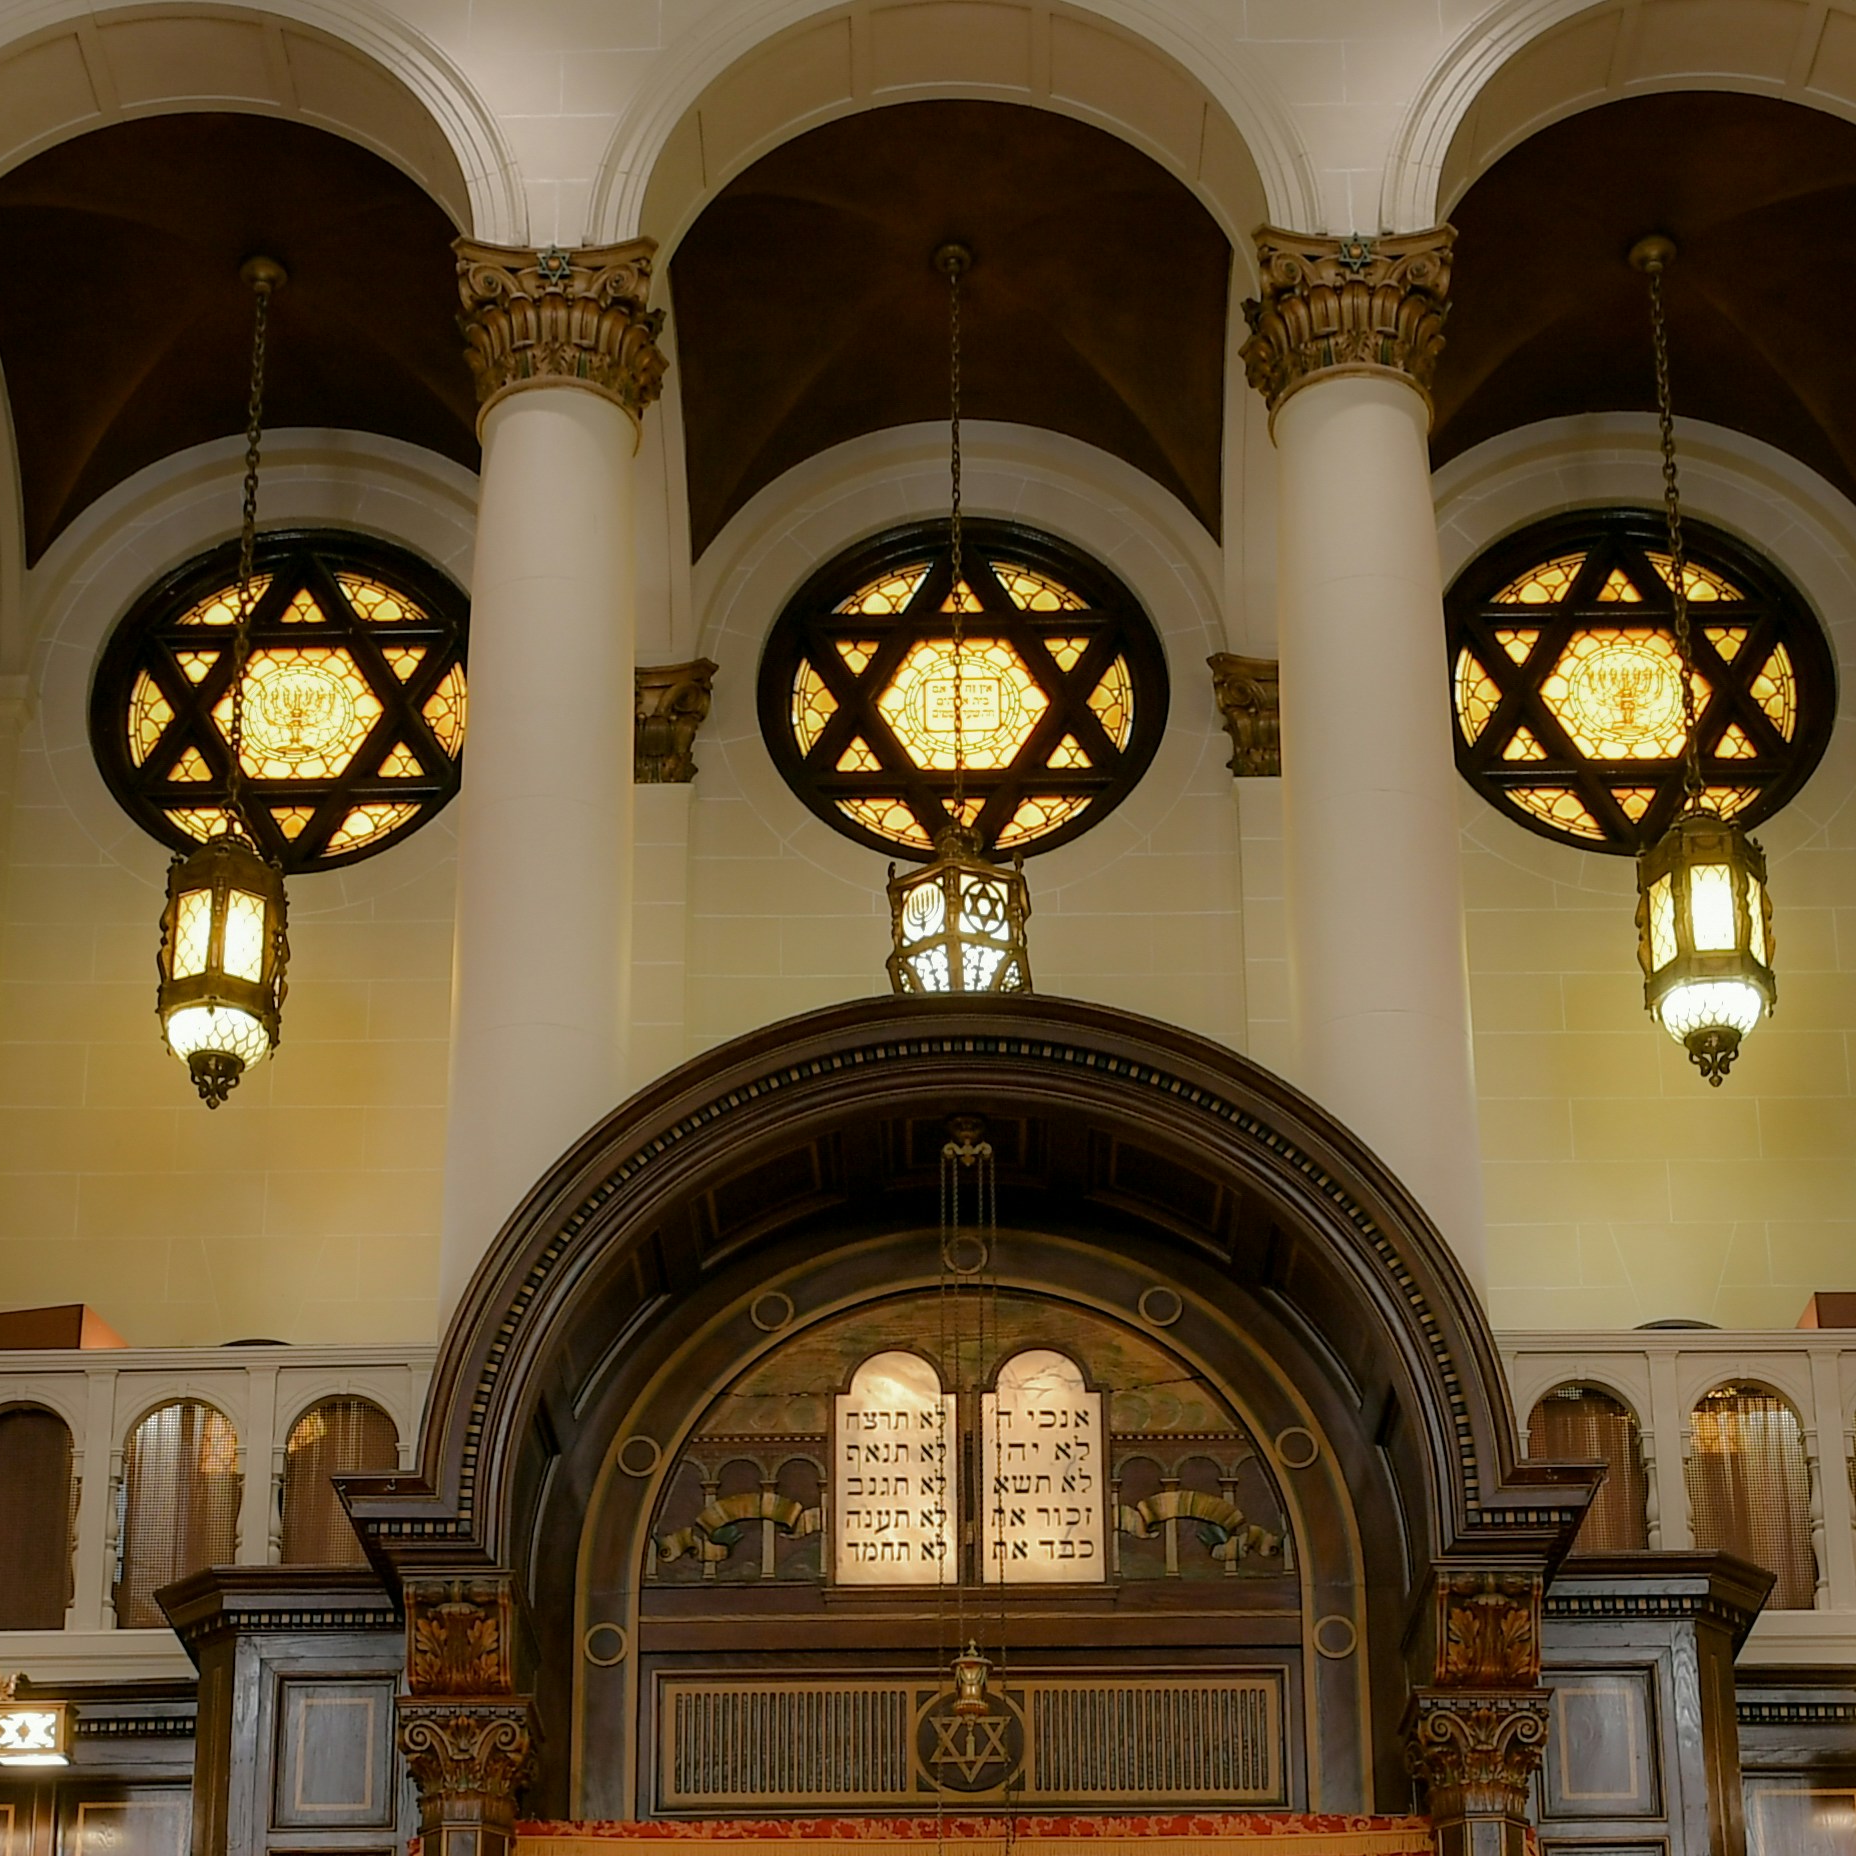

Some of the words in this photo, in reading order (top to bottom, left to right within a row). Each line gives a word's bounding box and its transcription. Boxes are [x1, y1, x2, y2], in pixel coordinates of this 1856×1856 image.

[846, 1411, 909, 1430] תרצח
[920, 1404, 947, 1430] לא
[1027, 1409, 1089, 1429] אנכי
[846, 1443, 909, 1473] תנאף
[920, 1436, 947, 1463] לא
[1055, 1435, 1090, 1461] לא
[847, 1476, 909, 1496] תגנב
[920, 1468, 947, 1496] לא
[993, 1475, 1051, 1494] תשא
[1061, 1467, 1093, 1493] לא
[846, 1509, 910, 1535] תענה
[920, 1501, 947, 1528] לא
[991, 1507, 1026, 1527] את
[1036, 1507, 1092, 1526] זכור
[846, 1541, 911, 1562] תחמד
[921, 1533, 948, 1561] לא
[992, 1540, 1028, 1560] את
[1038, 1540, 1094, 1559] כבד
